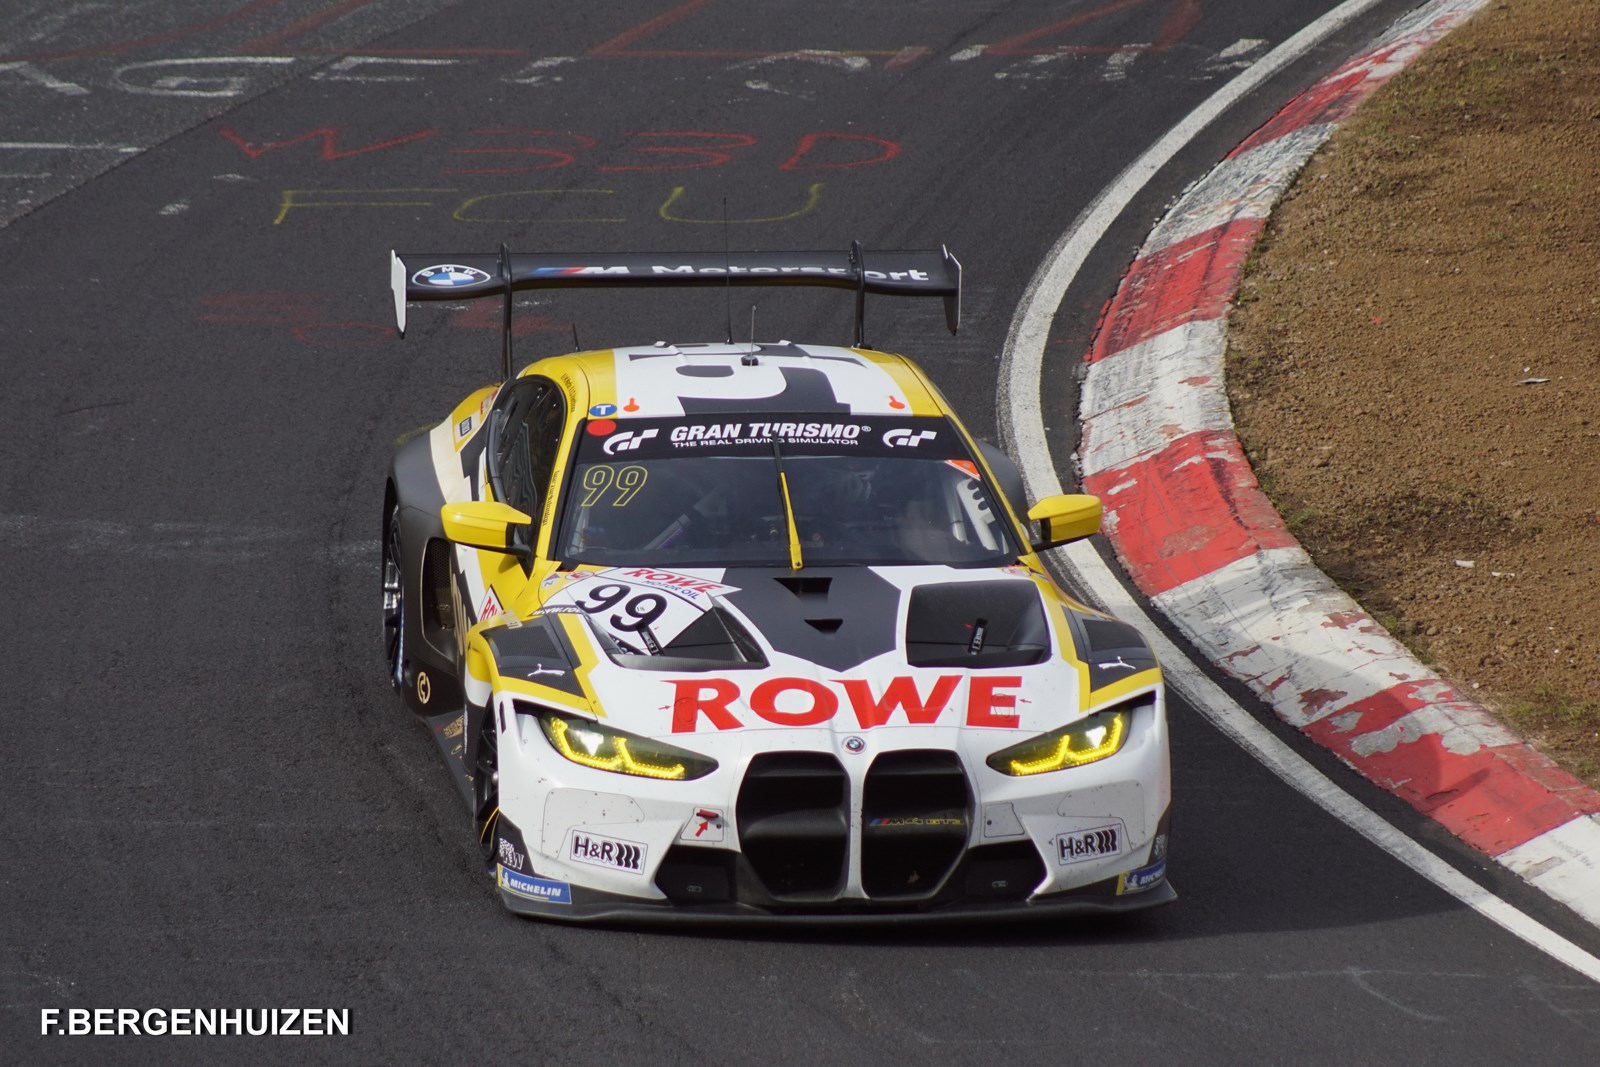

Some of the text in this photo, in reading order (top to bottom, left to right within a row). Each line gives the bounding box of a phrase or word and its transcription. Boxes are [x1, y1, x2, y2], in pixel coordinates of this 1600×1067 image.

[421, 266, 477, 277] BMW
[670, 423, 742, 442] GRAN
[581, 465, 648, 506] 99
[623, 568, 724, 593] ROWE
[575, 583, 668, 633] 99
[660, 674, 1023, 733] ROWE
[510, 878, 562, 897] MICHELIN
